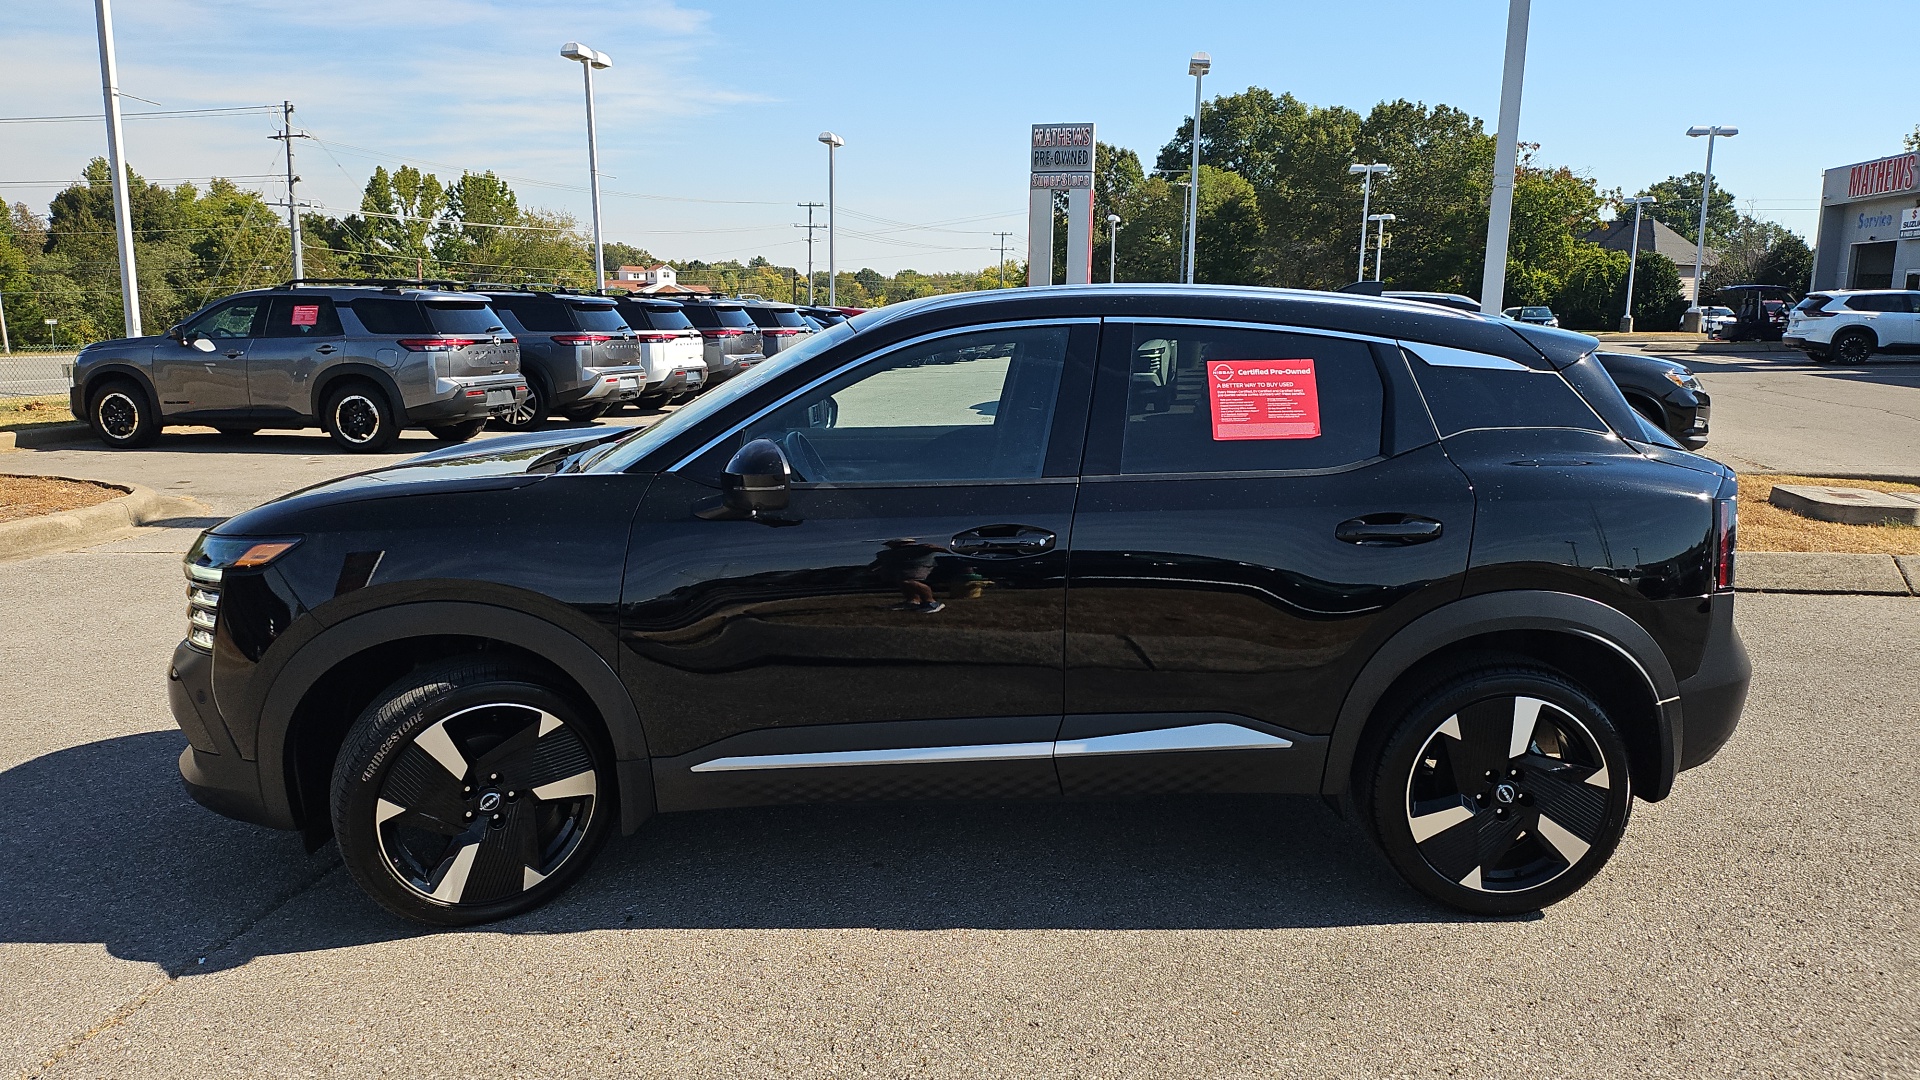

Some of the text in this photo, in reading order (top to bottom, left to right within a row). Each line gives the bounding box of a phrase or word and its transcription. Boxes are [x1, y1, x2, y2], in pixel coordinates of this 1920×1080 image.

[1033, 127, 1090, 146] MATHEWS
[1034, 150, 1088, 166] PRE-OWNED
[1848, 154, 1916, 198] MATHEWS
[1858, 212, 1893, 229] Service
[1270, 367, 1311, 375] Pre-Owned
[361, 709, 425, 782] BRIDGESTONE
